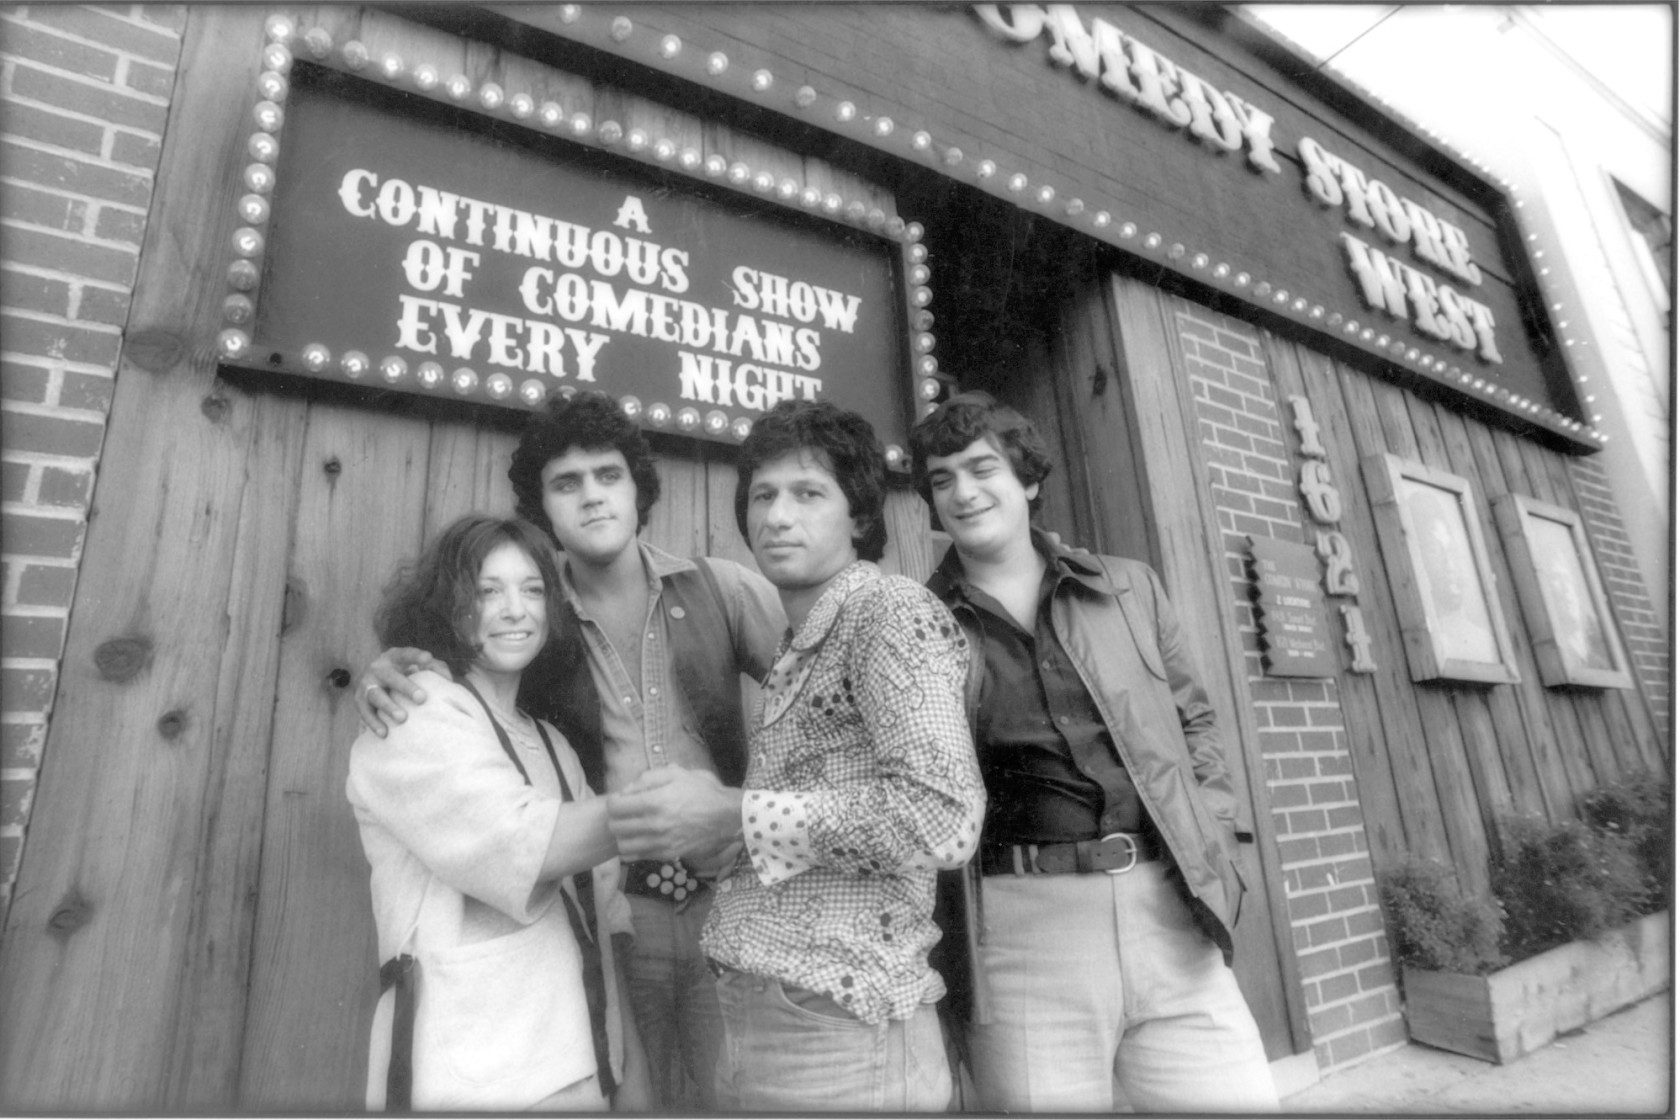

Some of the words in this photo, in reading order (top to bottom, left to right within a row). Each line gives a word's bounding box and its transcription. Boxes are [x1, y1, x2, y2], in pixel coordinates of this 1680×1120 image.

[338, 168, 690, 293] CONTINUOUS
[731, 265, 862, 333] SHOW
[613, 195, 652, 234] A
[1298, 137, 1482, 286] STORE
[395, 294, 609, 382] EVERY
[678, 350, 822, 411] NIGHT
[402, 239, 480, 298] OF
[519, 266, 822, 371] COMEDIANS
[1340, 231, 1503, 364] WEST
[1289, 395, 1377, 672] 1621
